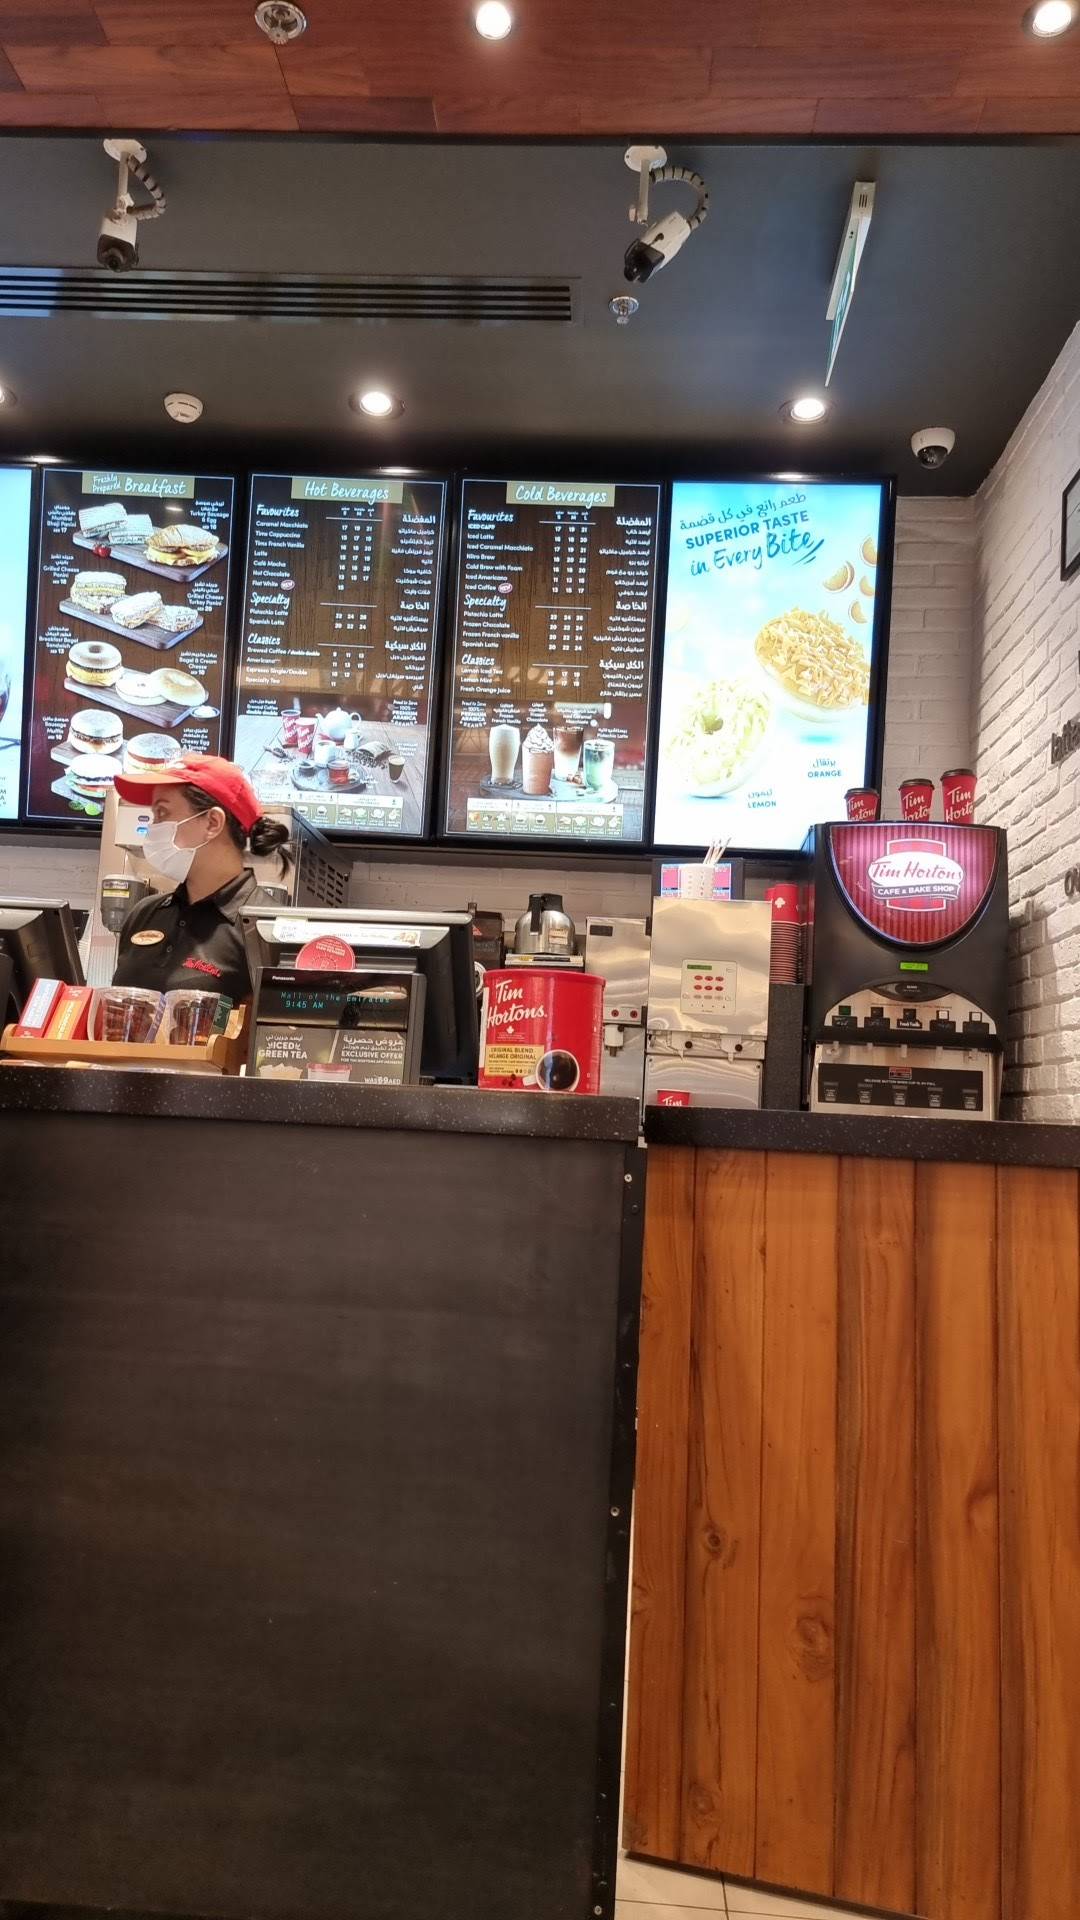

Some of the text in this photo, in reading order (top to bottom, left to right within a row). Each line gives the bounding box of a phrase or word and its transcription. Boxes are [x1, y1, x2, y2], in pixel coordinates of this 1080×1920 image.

[93, 473, 118, 485] Freshly
[92, 482, 121, 494] Prepared
[124, 477, 186, 498] Breakfast
[304, 480, 389, 505] Hot Beverages
[515, 485, 607, 509] Cold Beverages
[256, 504, 299, 517] Favourites
[467, 509, 514, 522] Favourites
[680, 493, 807, 531] طعم رائع في كل قضمة
[402, 513, 436, 525] المفضلة
[616, 516, 651, 526] المفضلة
[685, 510, 809, 550] SUPERIOR TASTE
[691, 527, 816, 576] in Every Bite
[263, 570, 290, 578] Chocolate
[250, 591, 290, 609] Specialty
[400, 600, 430, 610] الخاصة
[463, 593, 507, 611] Specialty
[616, 601, 647, 611] الخاصة
[247, 632, 281, 645] Classics
[461, 654, 495, 666] Classics
[812, 758, 836, 768] برتقال
[807, 770, 842, 778] ORANGE
[902, 792, 925, 810] Tim
[946, 786, 971, 805] Tim
[747, 801, 777, 809] LEMON
[847, 797, 864, 813] Tim
[871, 861, 962, 880] Tim Hortons
[878, 888, 900, 896] CAFE
[908, 886, 931, 895] BAKE
[933, 885, 955, 893] SHOP
[281, 991, 391, 1004] Mall of the Emirates
[495, 979, 523, 1004] Tim
[284, 1001, 325, 1009] 9:45 AM
[272, 1041, 295, 1050] ICED
[343, 1034, 404, 1047] عروض حصرية
[258, 1049, 308, 1060] GREEN TEA
[341, 1050, 403, 1060] EXCLUSIVE OFFER
[662, 1096, 682, 1106] Tim
